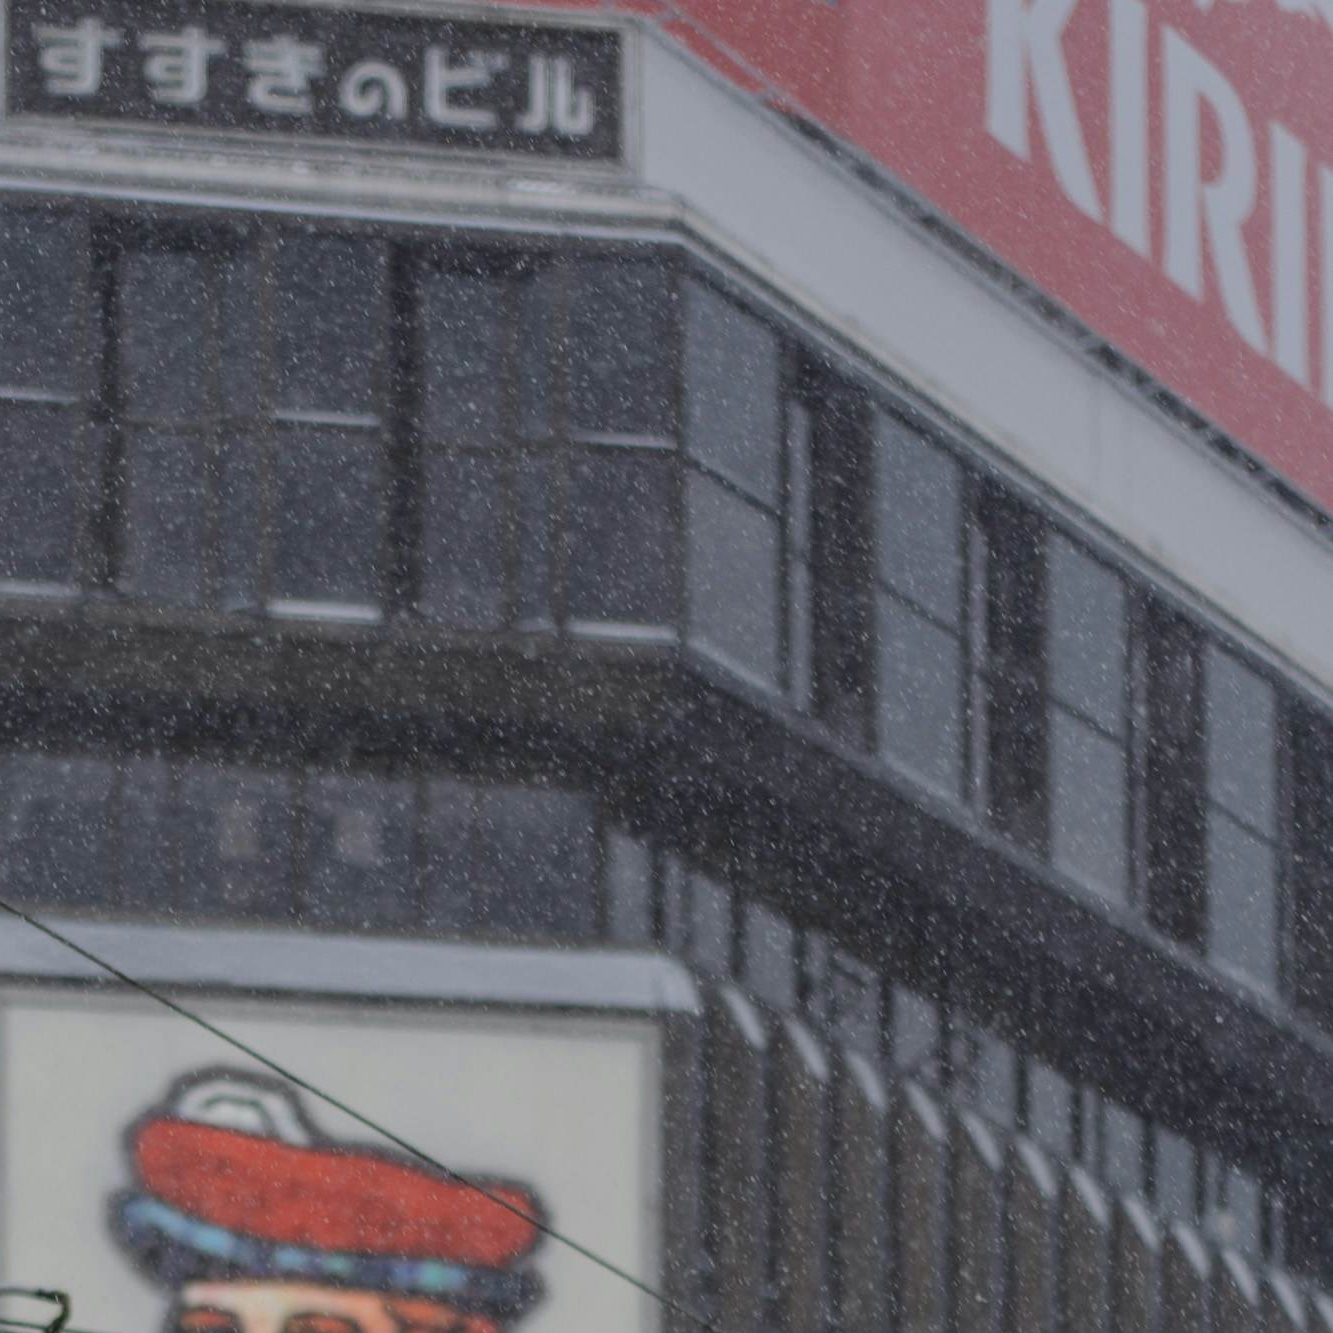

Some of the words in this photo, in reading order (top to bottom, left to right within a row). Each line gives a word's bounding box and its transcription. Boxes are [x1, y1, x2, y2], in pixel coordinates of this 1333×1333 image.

[31, 15, 596, 138] すすきのビル
[984, 0, 1333, 412] KIRI
